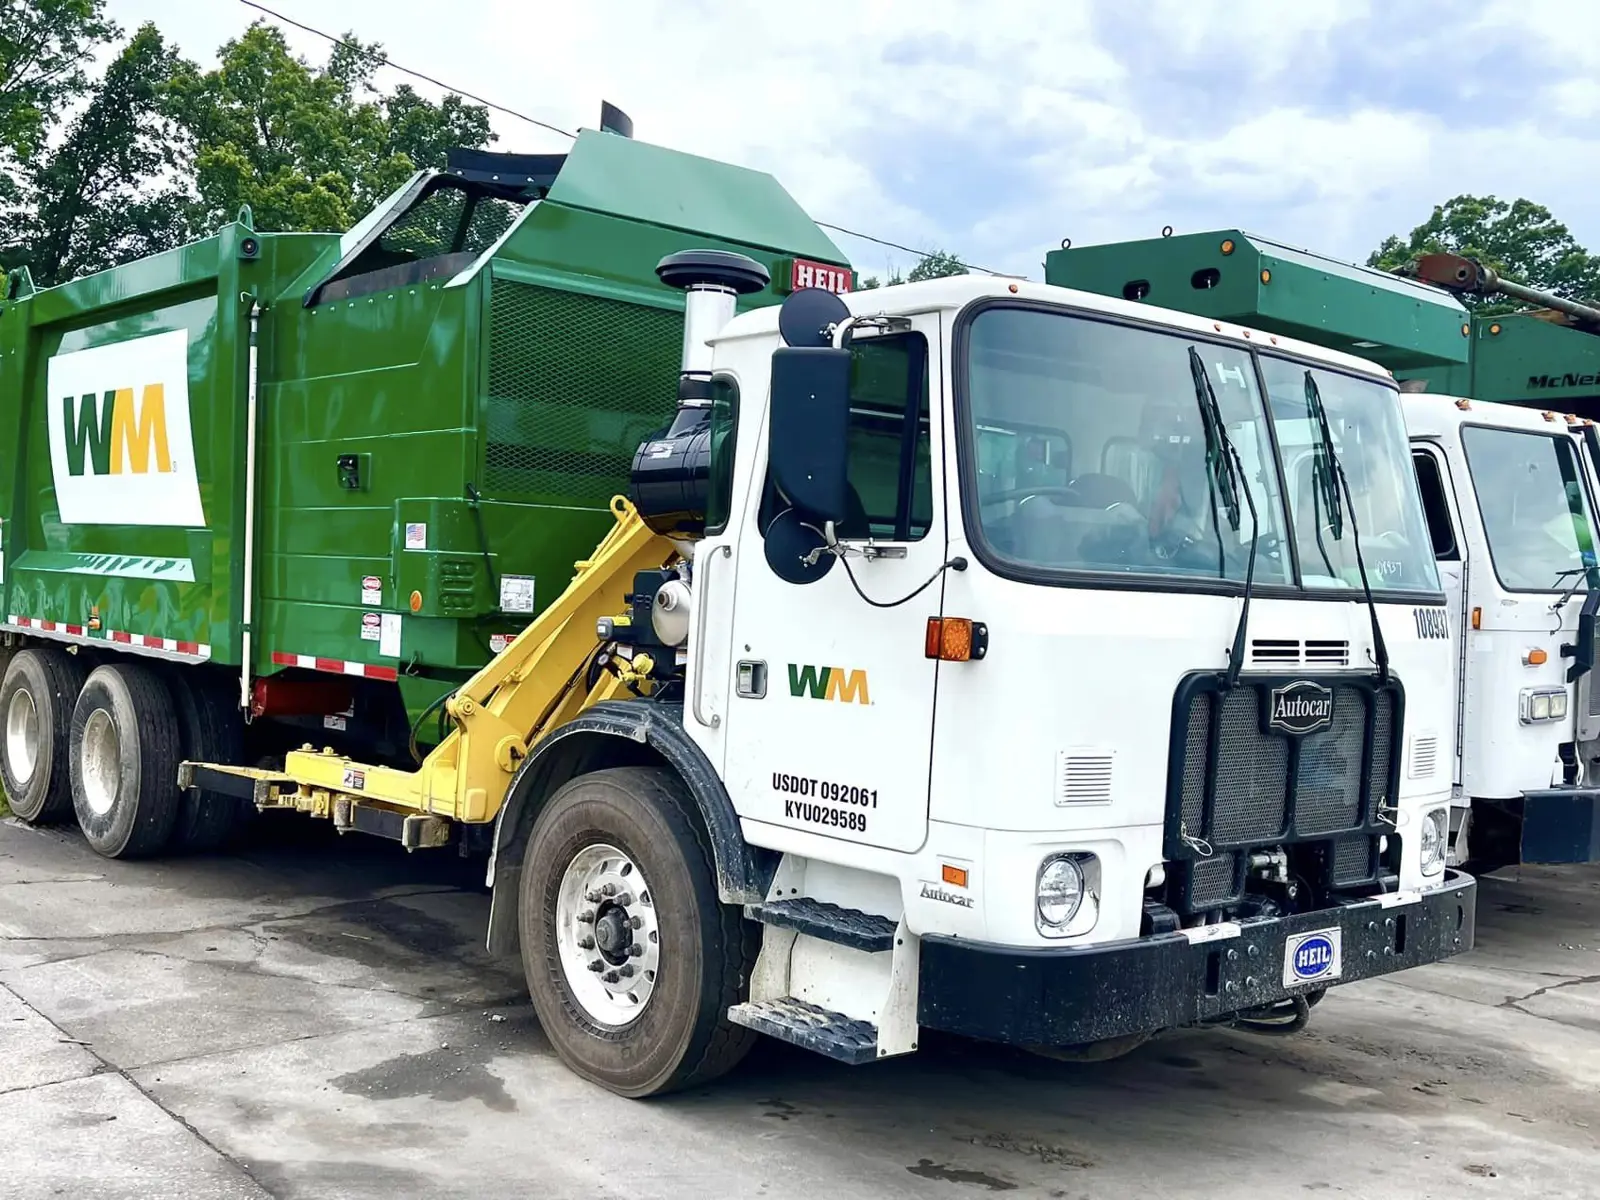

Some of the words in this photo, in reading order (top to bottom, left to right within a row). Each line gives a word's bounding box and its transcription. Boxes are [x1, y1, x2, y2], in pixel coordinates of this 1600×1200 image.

[797, 265, 848, 294] HEIL
[63, 382, 172, 476] WM
[1413, 608, 1449, 640] 108937
[787, 663, 870, 705] WM
[1274, 694, 1330, 718] Autocar
[772, 772, 818, 797] USDOT
[820, 781, 878, 809] 092061
[785, 799, 867, 832] KYU029589
[919, 882, 975, 909] Autocar
[1298, 945, 1330, 968] HEIL
